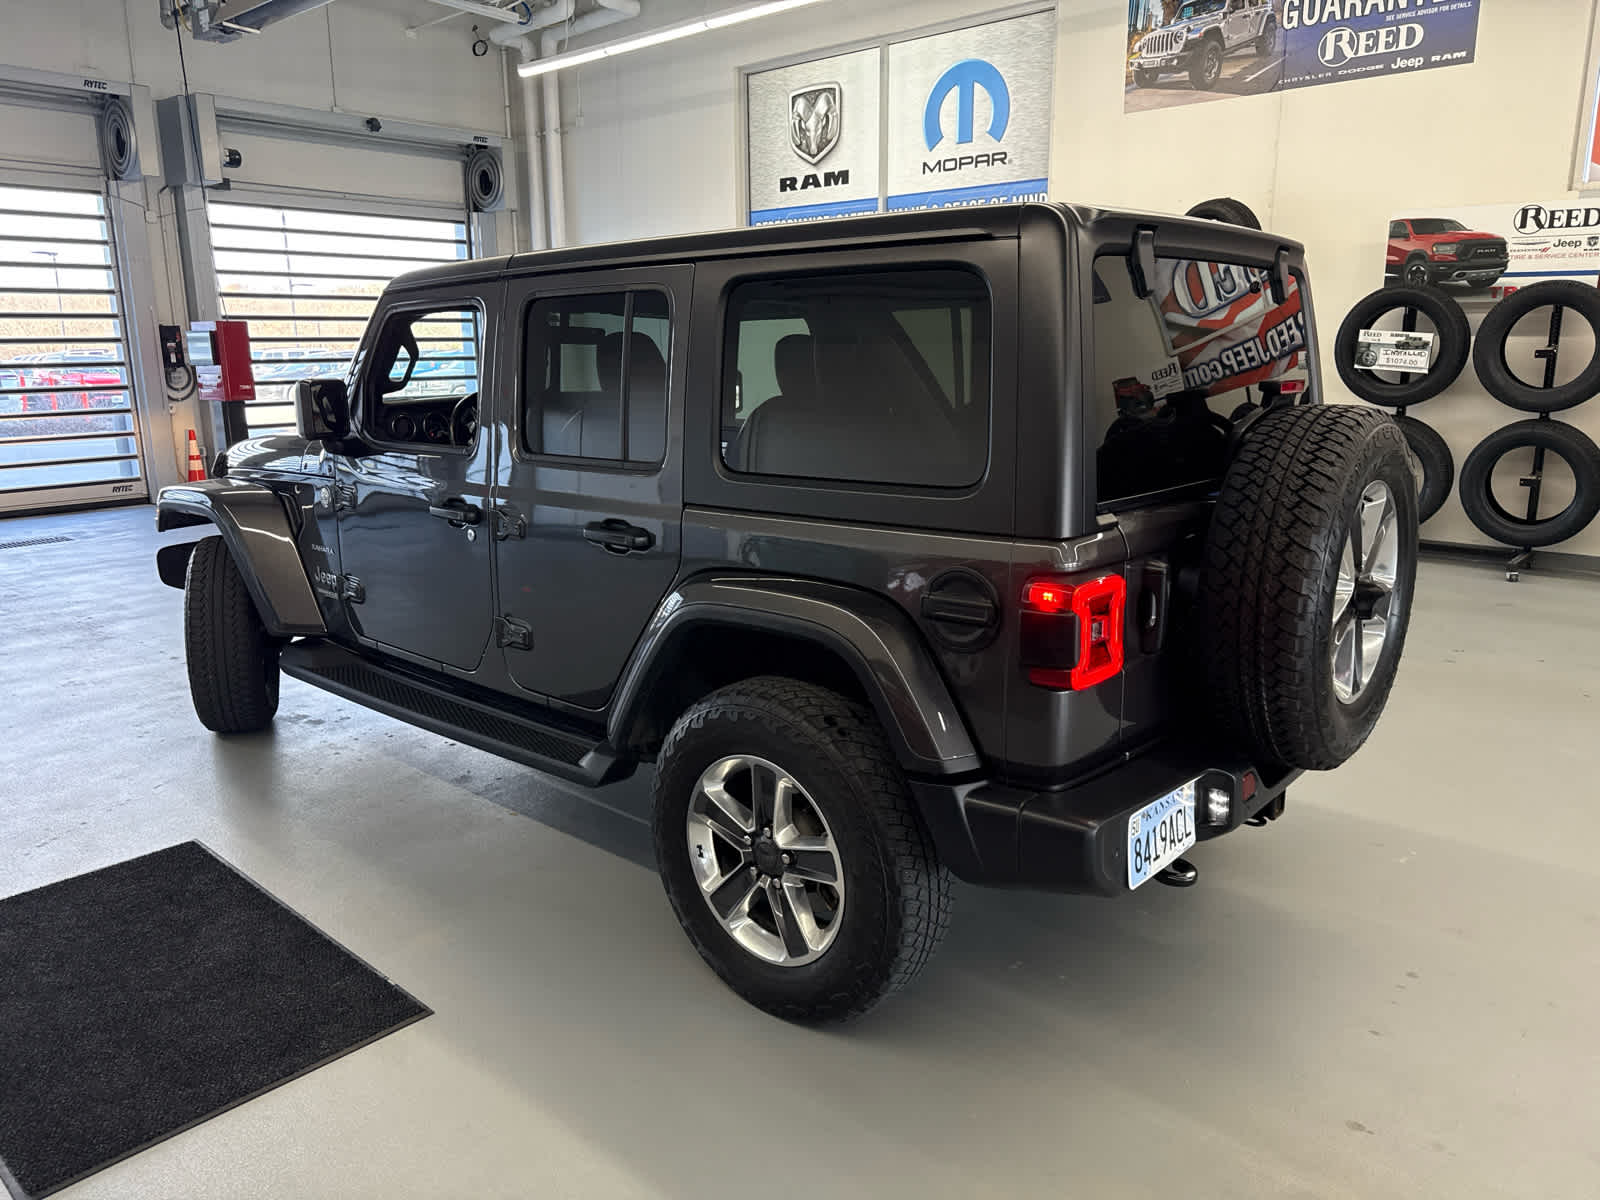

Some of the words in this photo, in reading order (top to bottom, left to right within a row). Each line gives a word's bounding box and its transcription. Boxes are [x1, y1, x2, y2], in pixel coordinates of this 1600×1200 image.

[1417, 7, 1439, 16] ADVISOR
[1318, 23, 1424, 67] REED
[1278, 72, 1332, 85] CHRYSLER
[1338, 64, 1385, 75] DODGE
[1391, 55, 1424, 70] Jeep
[1431, 51, 1467, 62] RAM
[83, 79, 108, 89] RYTEC
[922, 151, 1008, 175] MOPAR
[779, 169, 849, 193] RAM
[1553, 239, 1582, 249] Jeep
[314, 565, 337, 592] Jeep
[1134, 804, 1192, 874] 8419ACL
